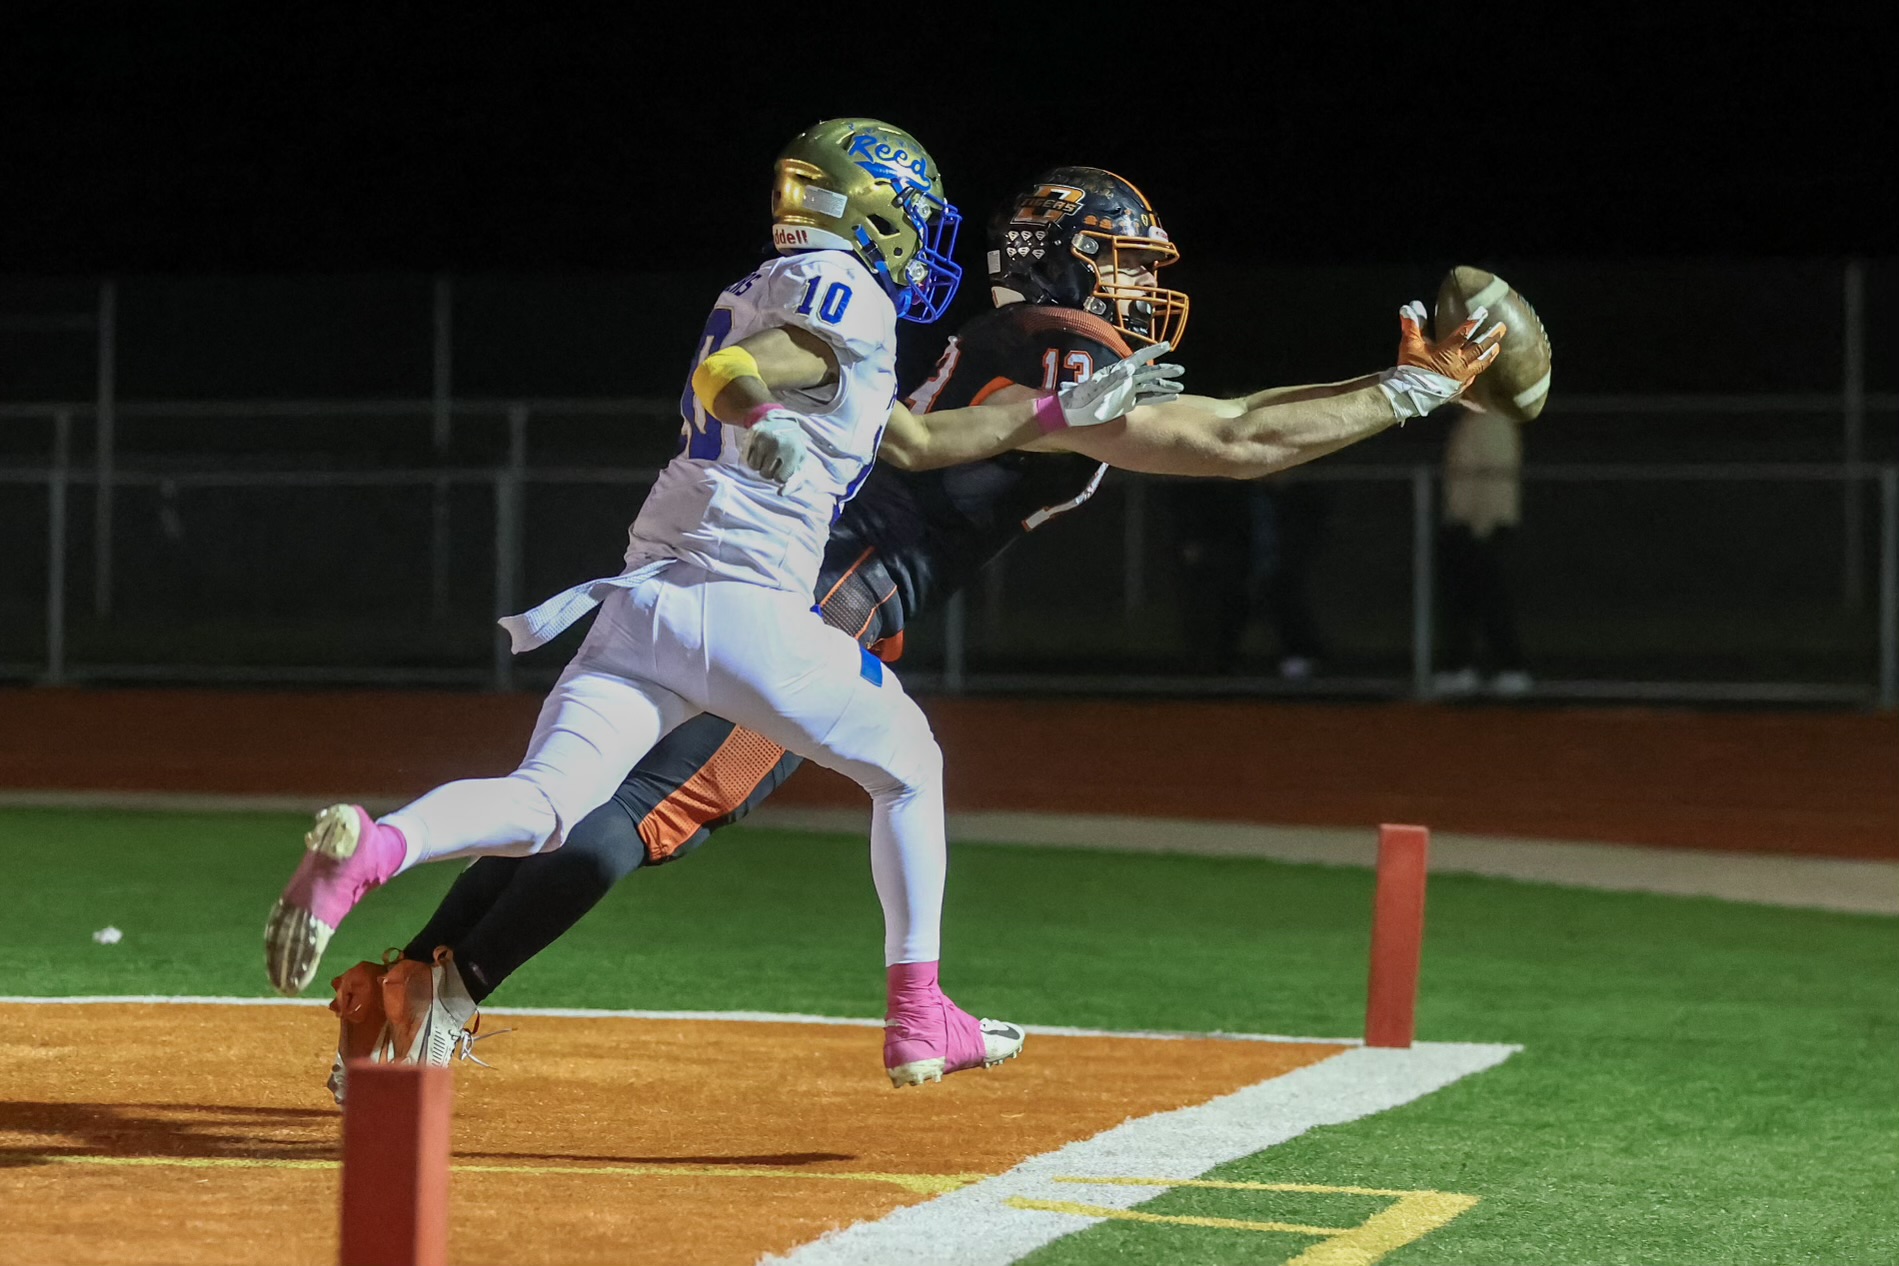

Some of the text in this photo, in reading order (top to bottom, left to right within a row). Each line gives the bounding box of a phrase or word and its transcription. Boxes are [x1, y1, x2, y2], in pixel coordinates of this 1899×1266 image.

[848, 135, 930, 184] Reed
[795, 275, 853, 325] 10
[1042, 348, 1094, 391] 13
